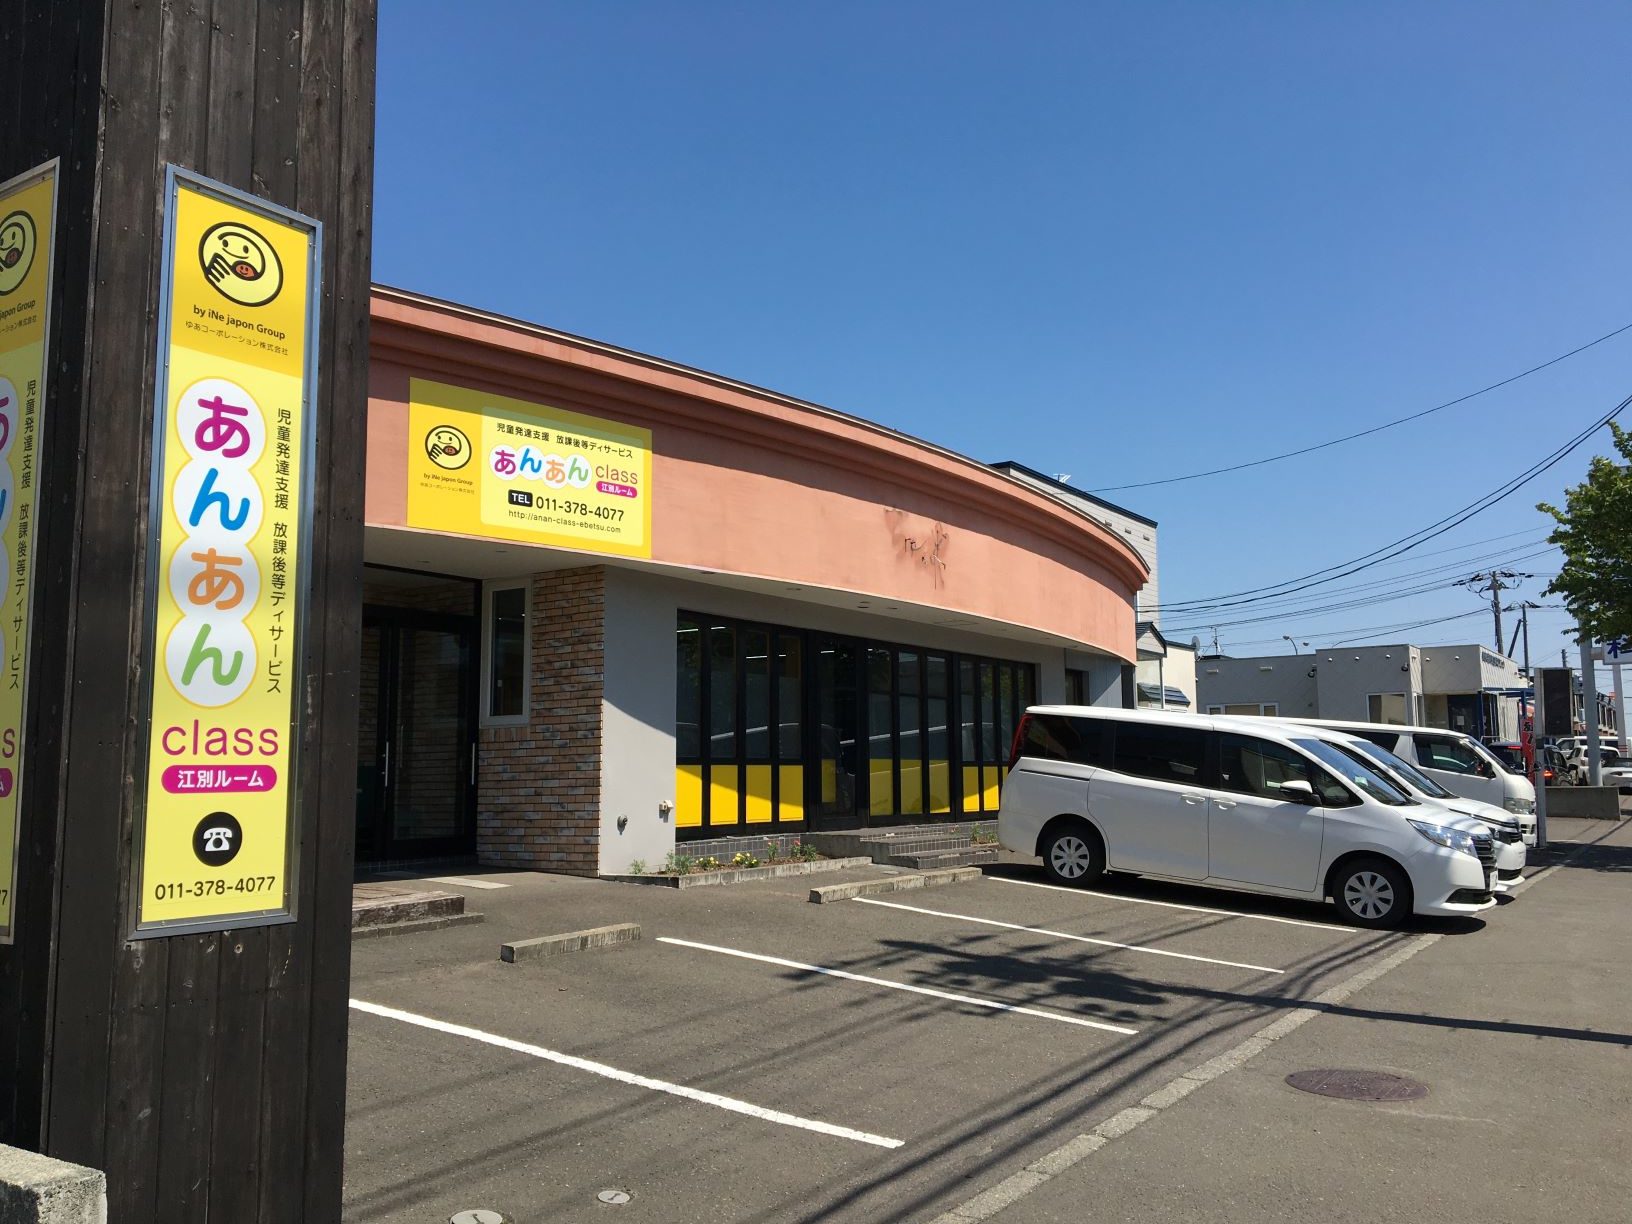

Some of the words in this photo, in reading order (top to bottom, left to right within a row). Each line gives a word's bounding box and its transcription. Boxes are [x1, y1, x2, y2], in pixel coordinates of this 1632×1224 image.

[193, 304, 206, 317] by
[208, 309, 225, 321] iNe
[226, 314, 254, 328] japon
[256, 323, 286, 340] Group
[496, 422, 550, 442] 児童発達支援
[273, 408, 292, 510] 児童発達支援
[494, 447, 589, 484] あんあん
[595, 464, 639, 485] class
[508, 509, 622, 533] http://anan-class-ebetsu.com
[511, 491, 531, 505] TEL
[535, 495, 625, 522] 011-378-4077
[266, 522, 288, 694] 放課後等ディサービス
[161, 719, 279, 757] class
[176, 768, 265, 789] 江別ルーム
[154, 875, 276, 901] 011-378-4077
